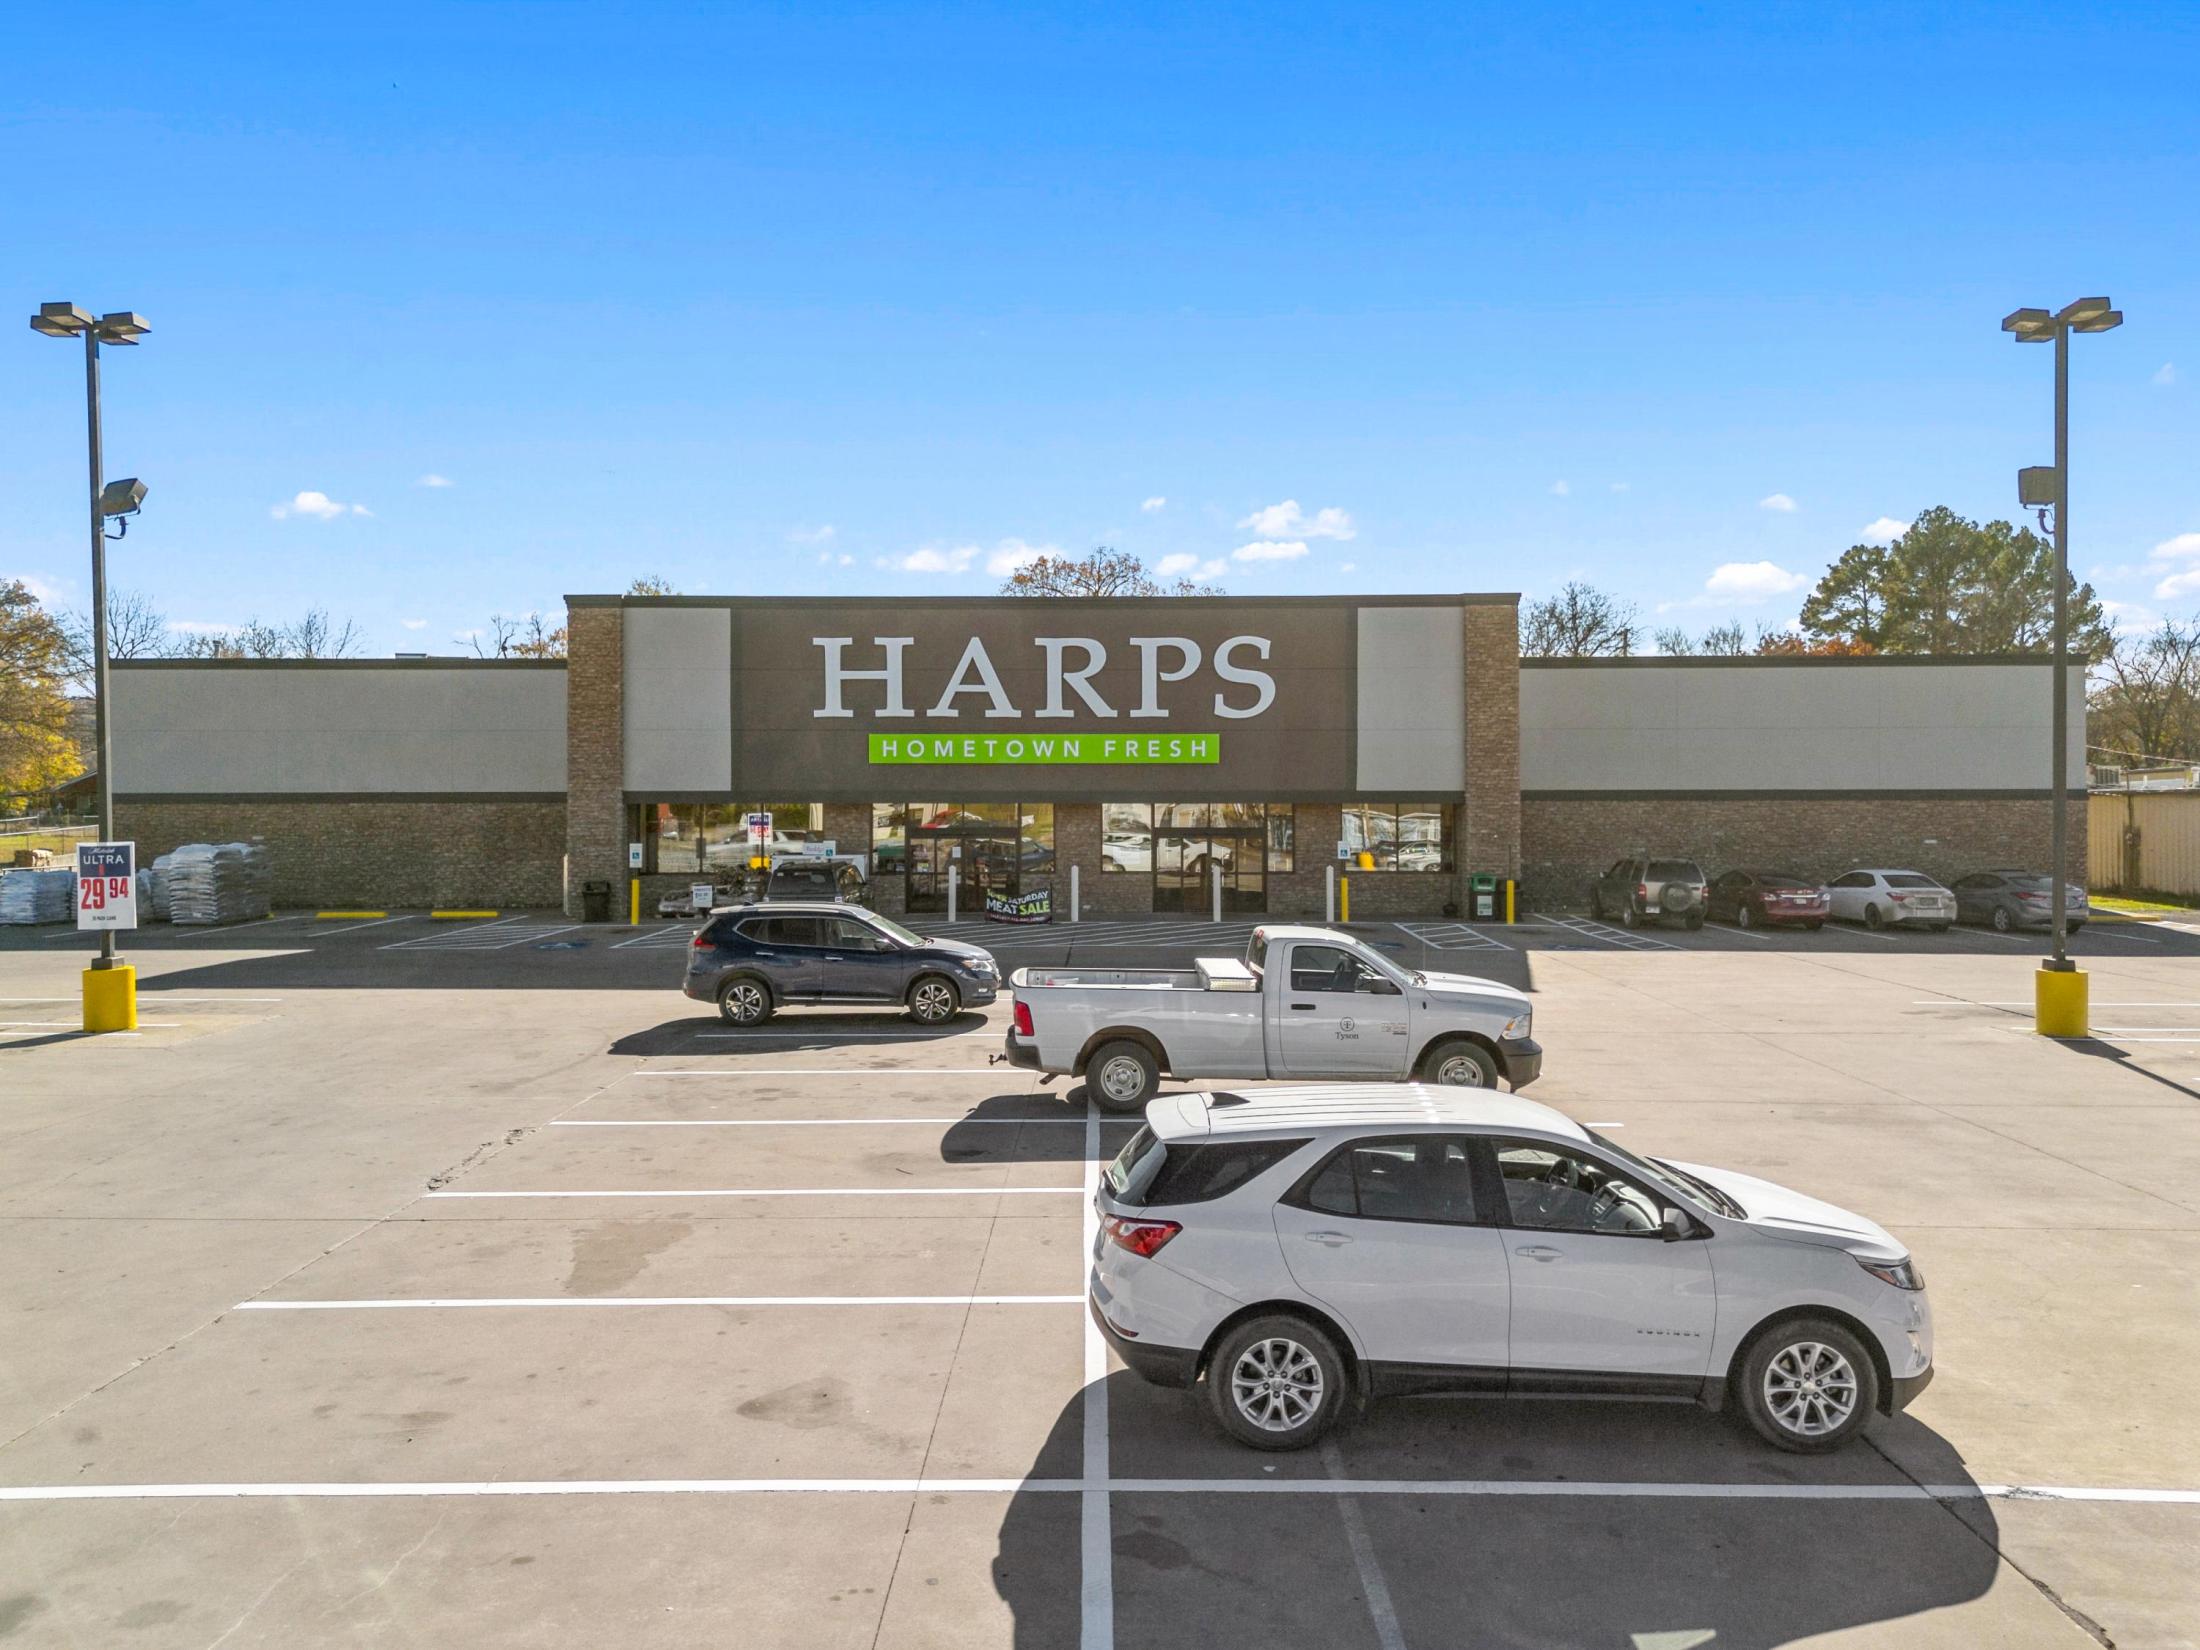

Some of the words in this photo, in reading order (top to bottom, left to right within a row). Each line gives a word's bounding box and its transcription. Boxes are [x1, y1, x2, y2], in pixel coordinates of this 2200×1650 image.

[812, 635, 1277, 719] HARPS
[882, 739, 1081, 759] HOMETOWN
[1104, 739, 1207, 759] FRESH
[83, 855, 124, 865] ULTRA
[81, 879, 105, 909] 29
[110, 878, 129, 898] 94
[986, 898, 1018, 915] MEAT
[1019, 901, 1050, 916] SALE
[1335, 1032, 1359, 1040] Tyson
